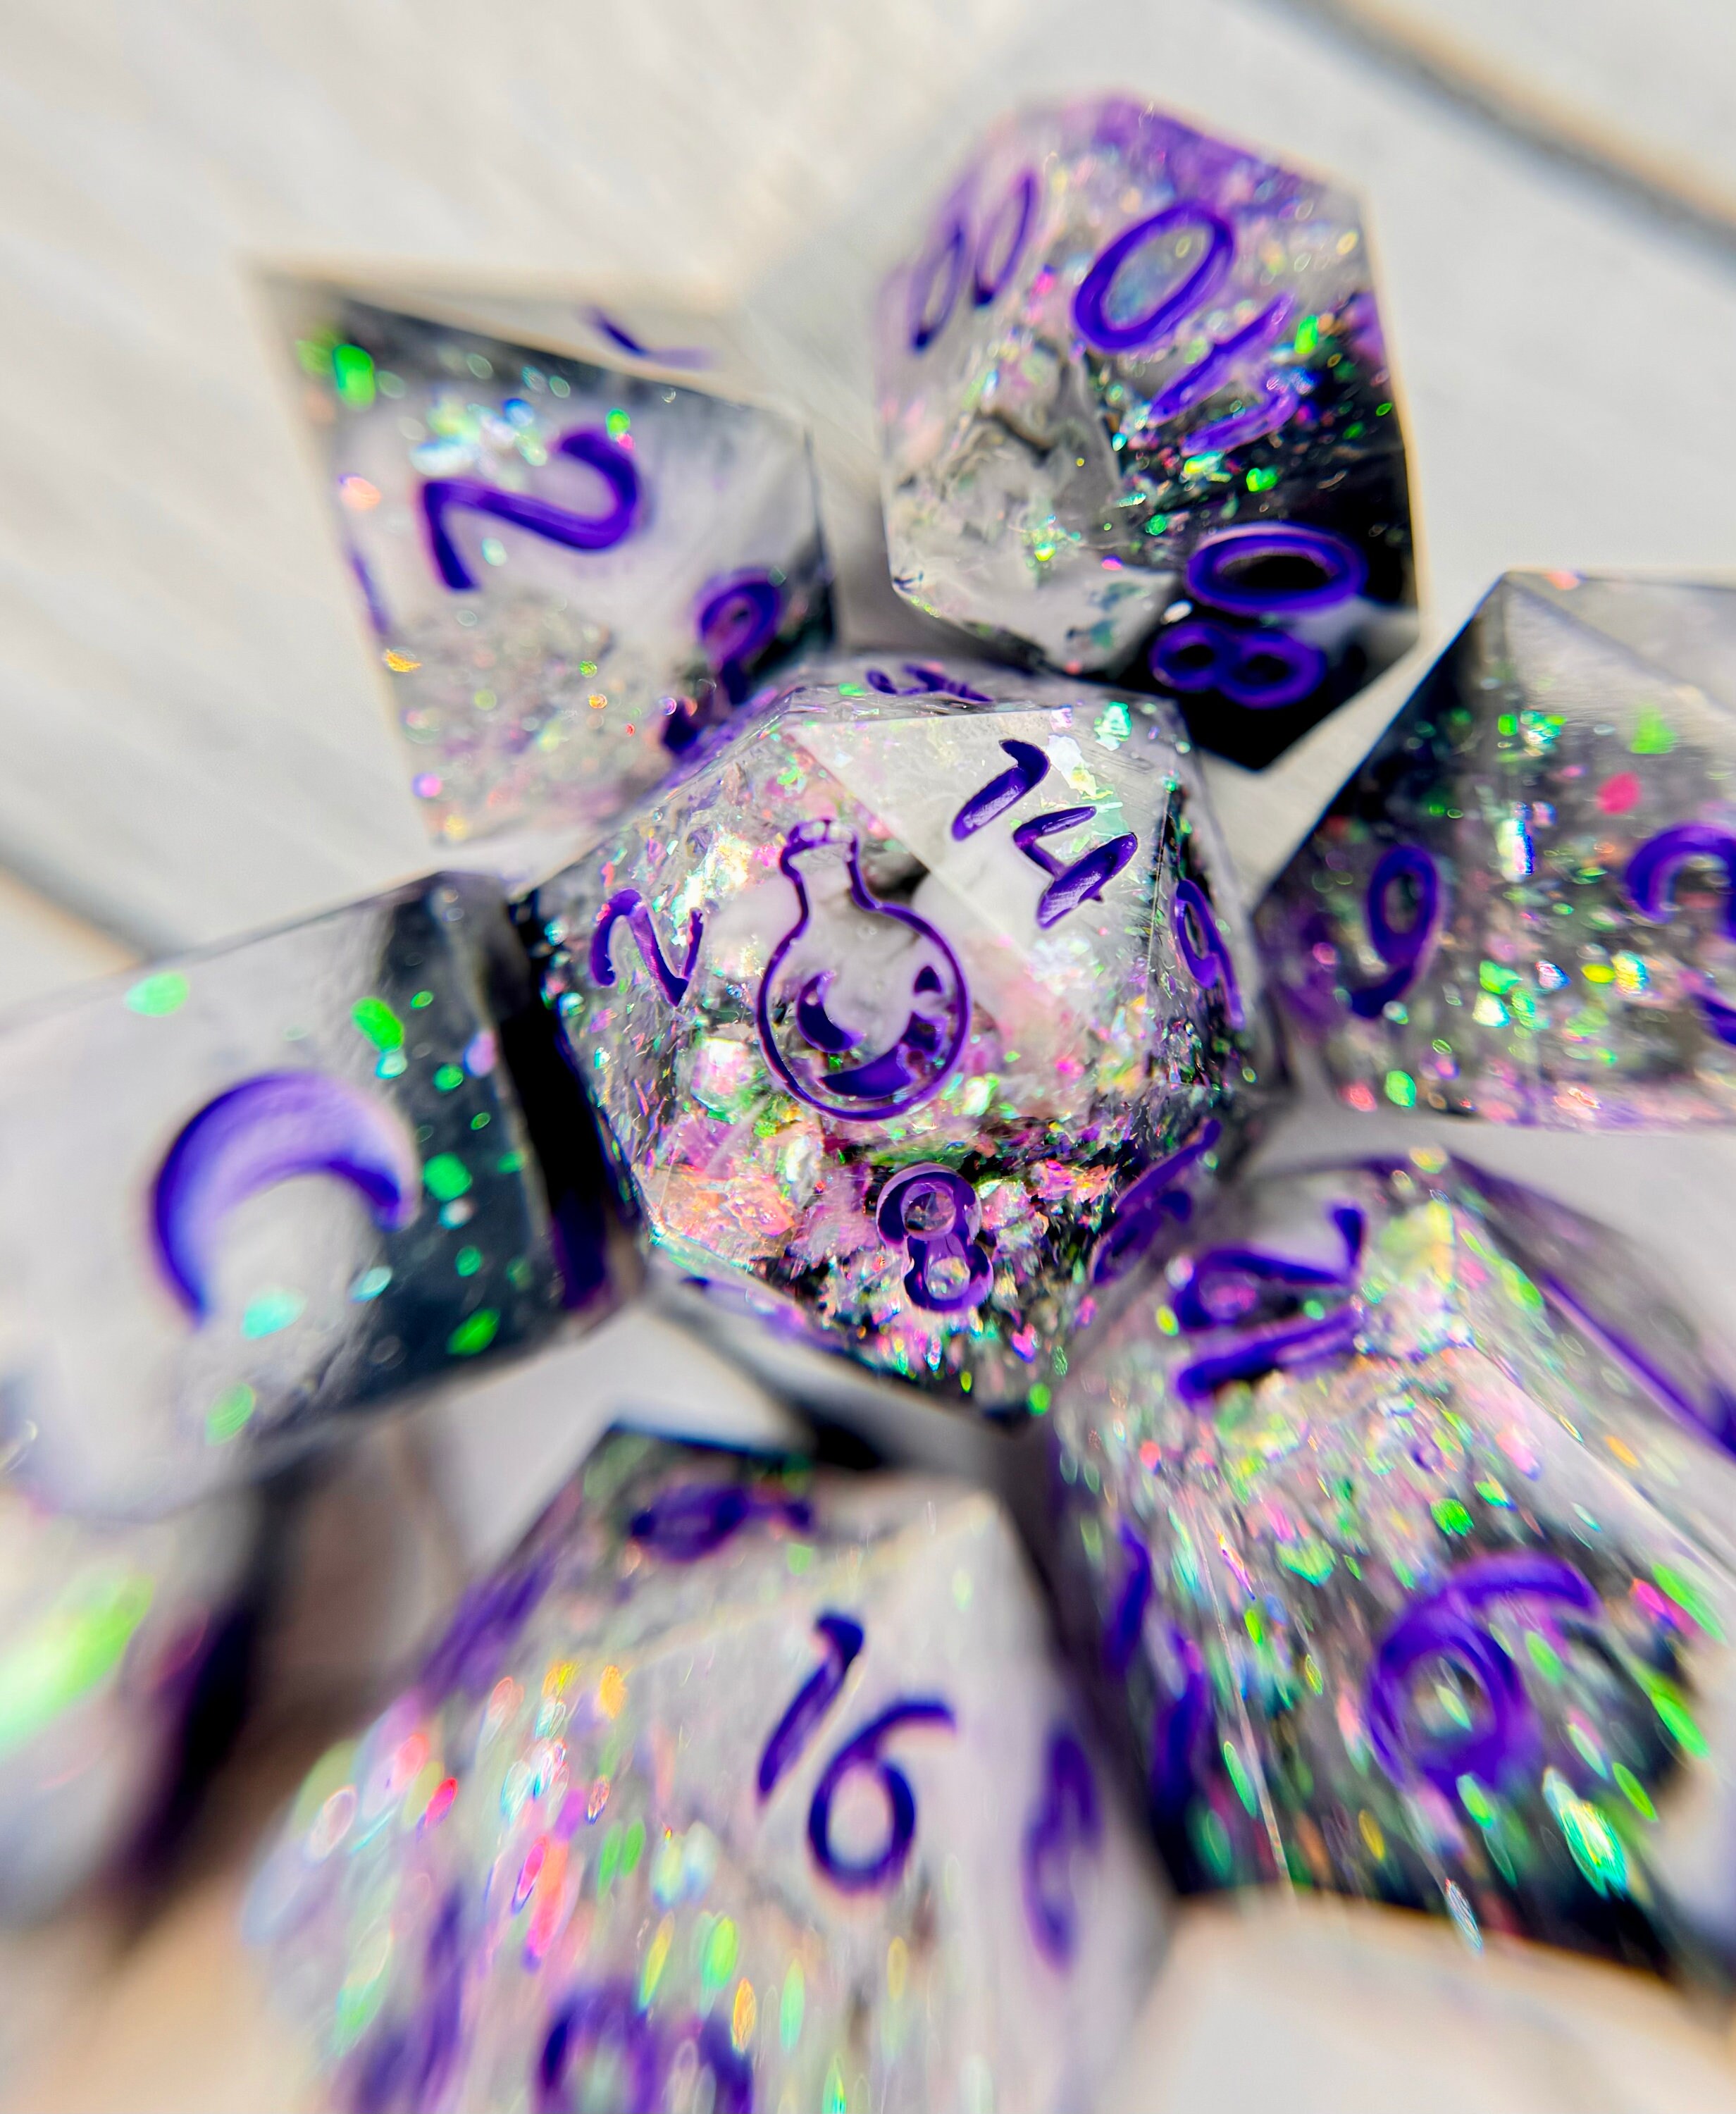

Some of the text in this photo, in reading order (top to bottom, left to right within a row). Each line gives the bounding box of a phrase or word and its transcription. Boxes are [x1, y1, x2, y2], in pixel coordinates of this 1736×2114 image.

[421, 431, 639, 592] 2
[1148, 521, 1368, 707] 80
[953, 737, 1138, 929] 14
[590, 886, 705, 1007] 2
[875, 1161, 994, 1313] 8
[757, 1609, 955, 1894] 16
[1367, 1550, 1603, 1790] 6
